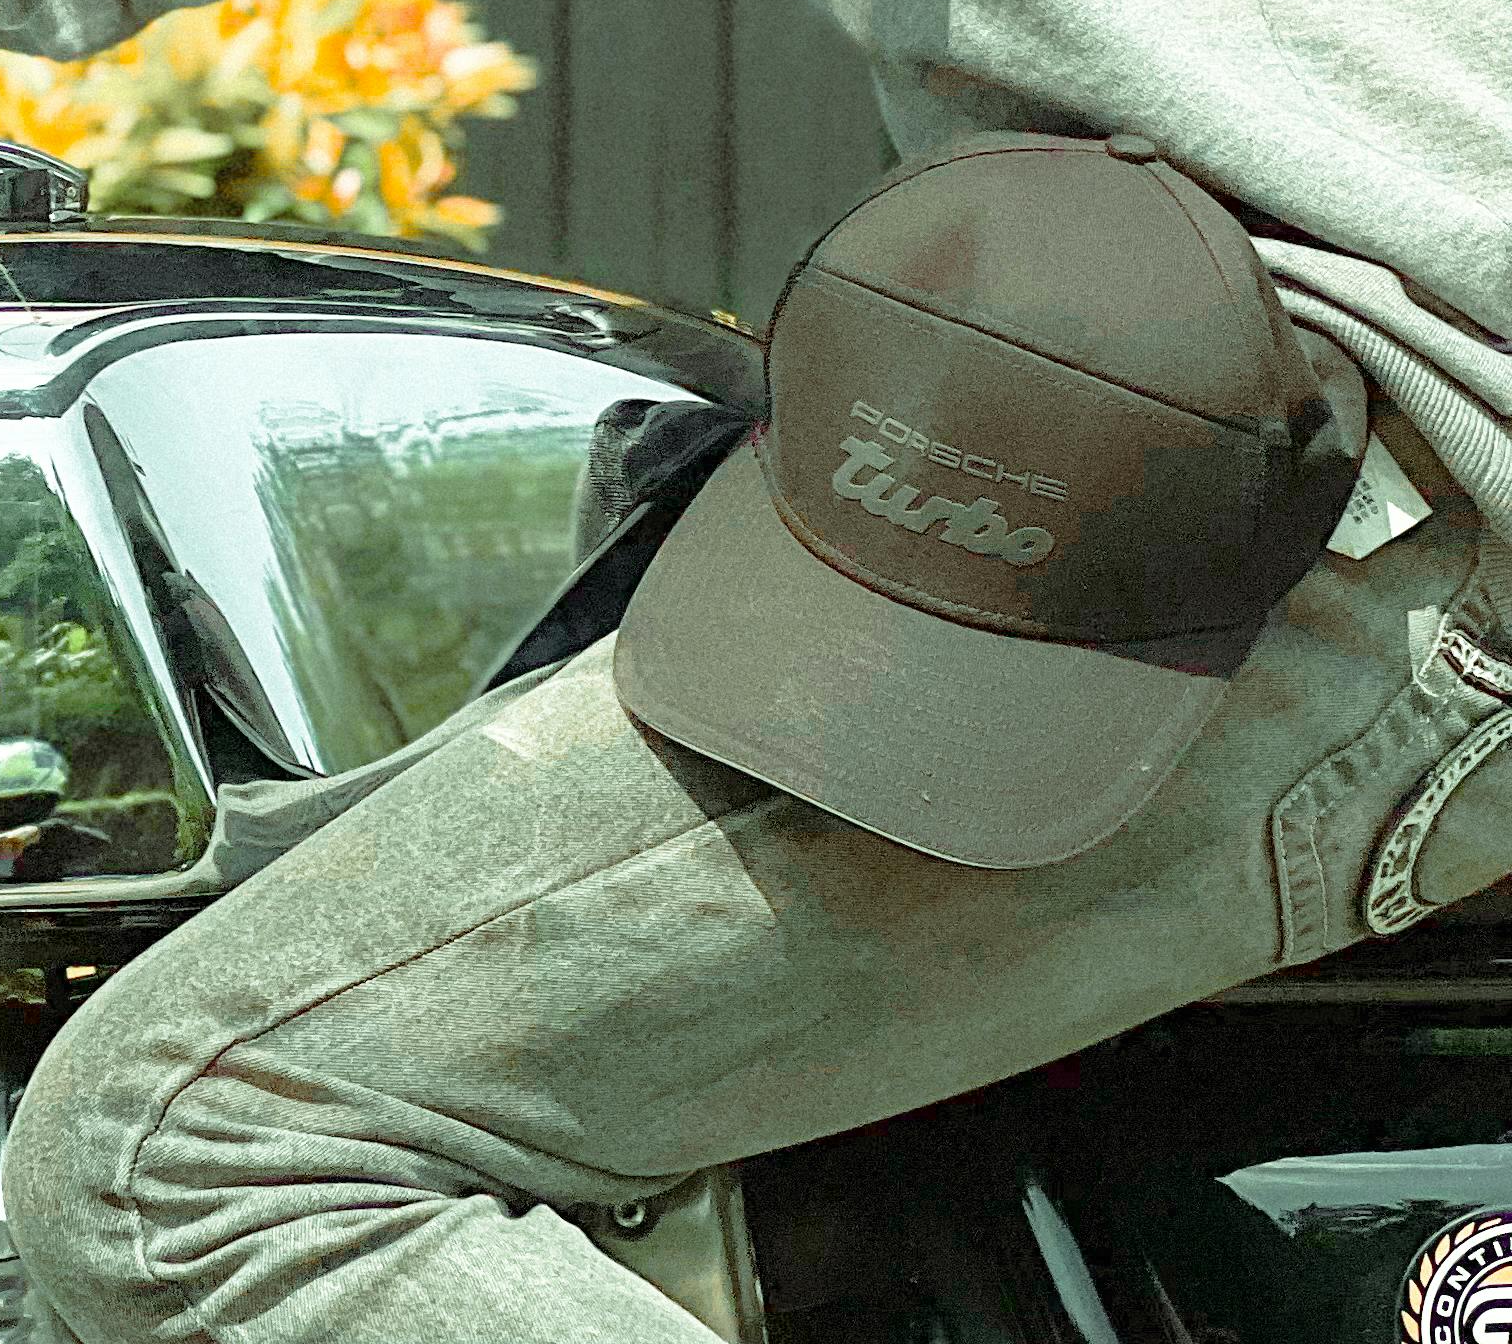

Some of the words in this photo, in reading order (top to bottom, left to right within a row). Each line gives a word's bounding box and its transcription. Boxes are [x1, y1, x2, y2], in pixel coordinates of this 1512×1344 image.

[832, 436, 1055, 568] turbo
[849, 400, 1069, 502] PORSCHE
[1434, 1236, 1512, 1344] CONTI
